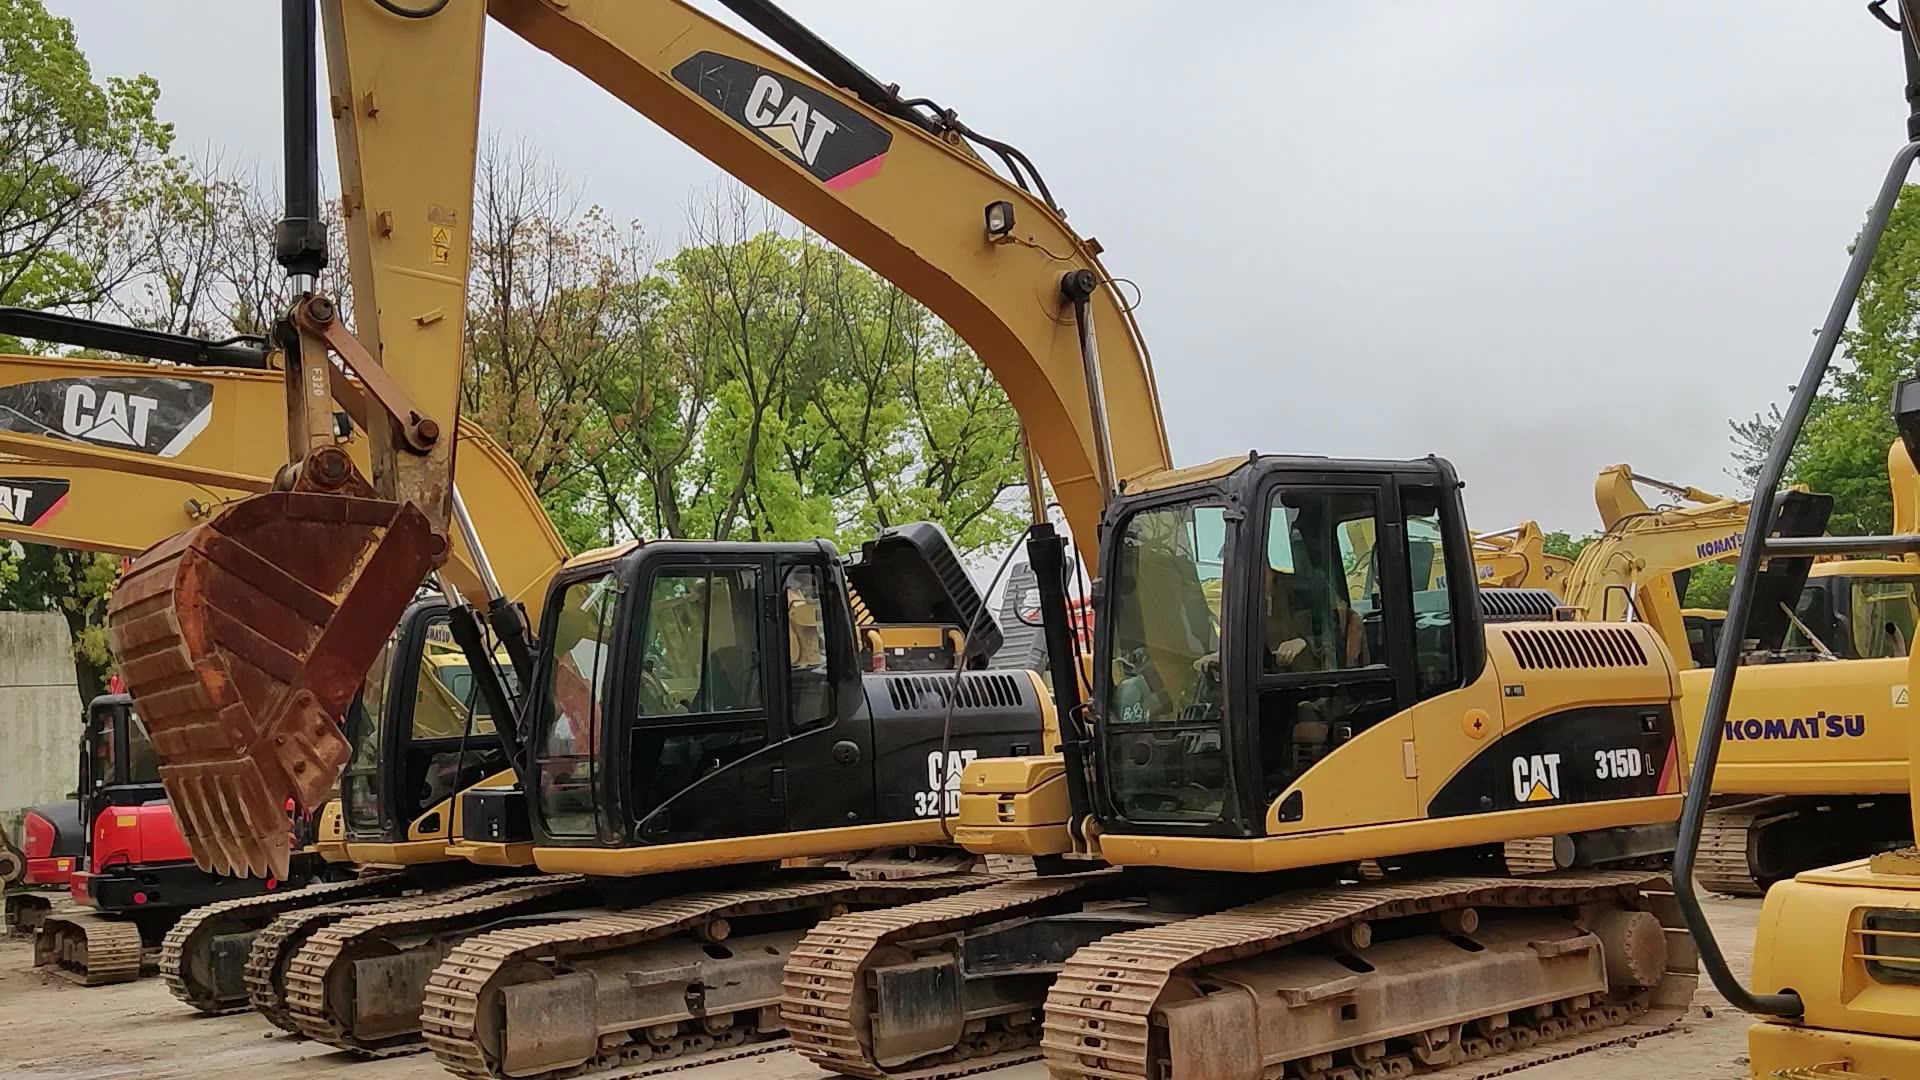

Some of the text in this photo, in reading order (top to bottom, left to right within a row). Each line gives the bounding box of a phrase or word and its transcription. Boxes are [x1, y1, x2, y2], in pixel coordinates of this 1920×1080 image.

[744, 74, 837, 166] CAT
[63, 384, 158, 447] CAT
[0, 486, 33, 522] AT
[1696, 532, 1743, 558] KOMATS
[1725, 711, 1866, 740] KOMATSU
[1512, 753, 1560, 802] CAT
[1594, 748, 1641, 779] 315D
